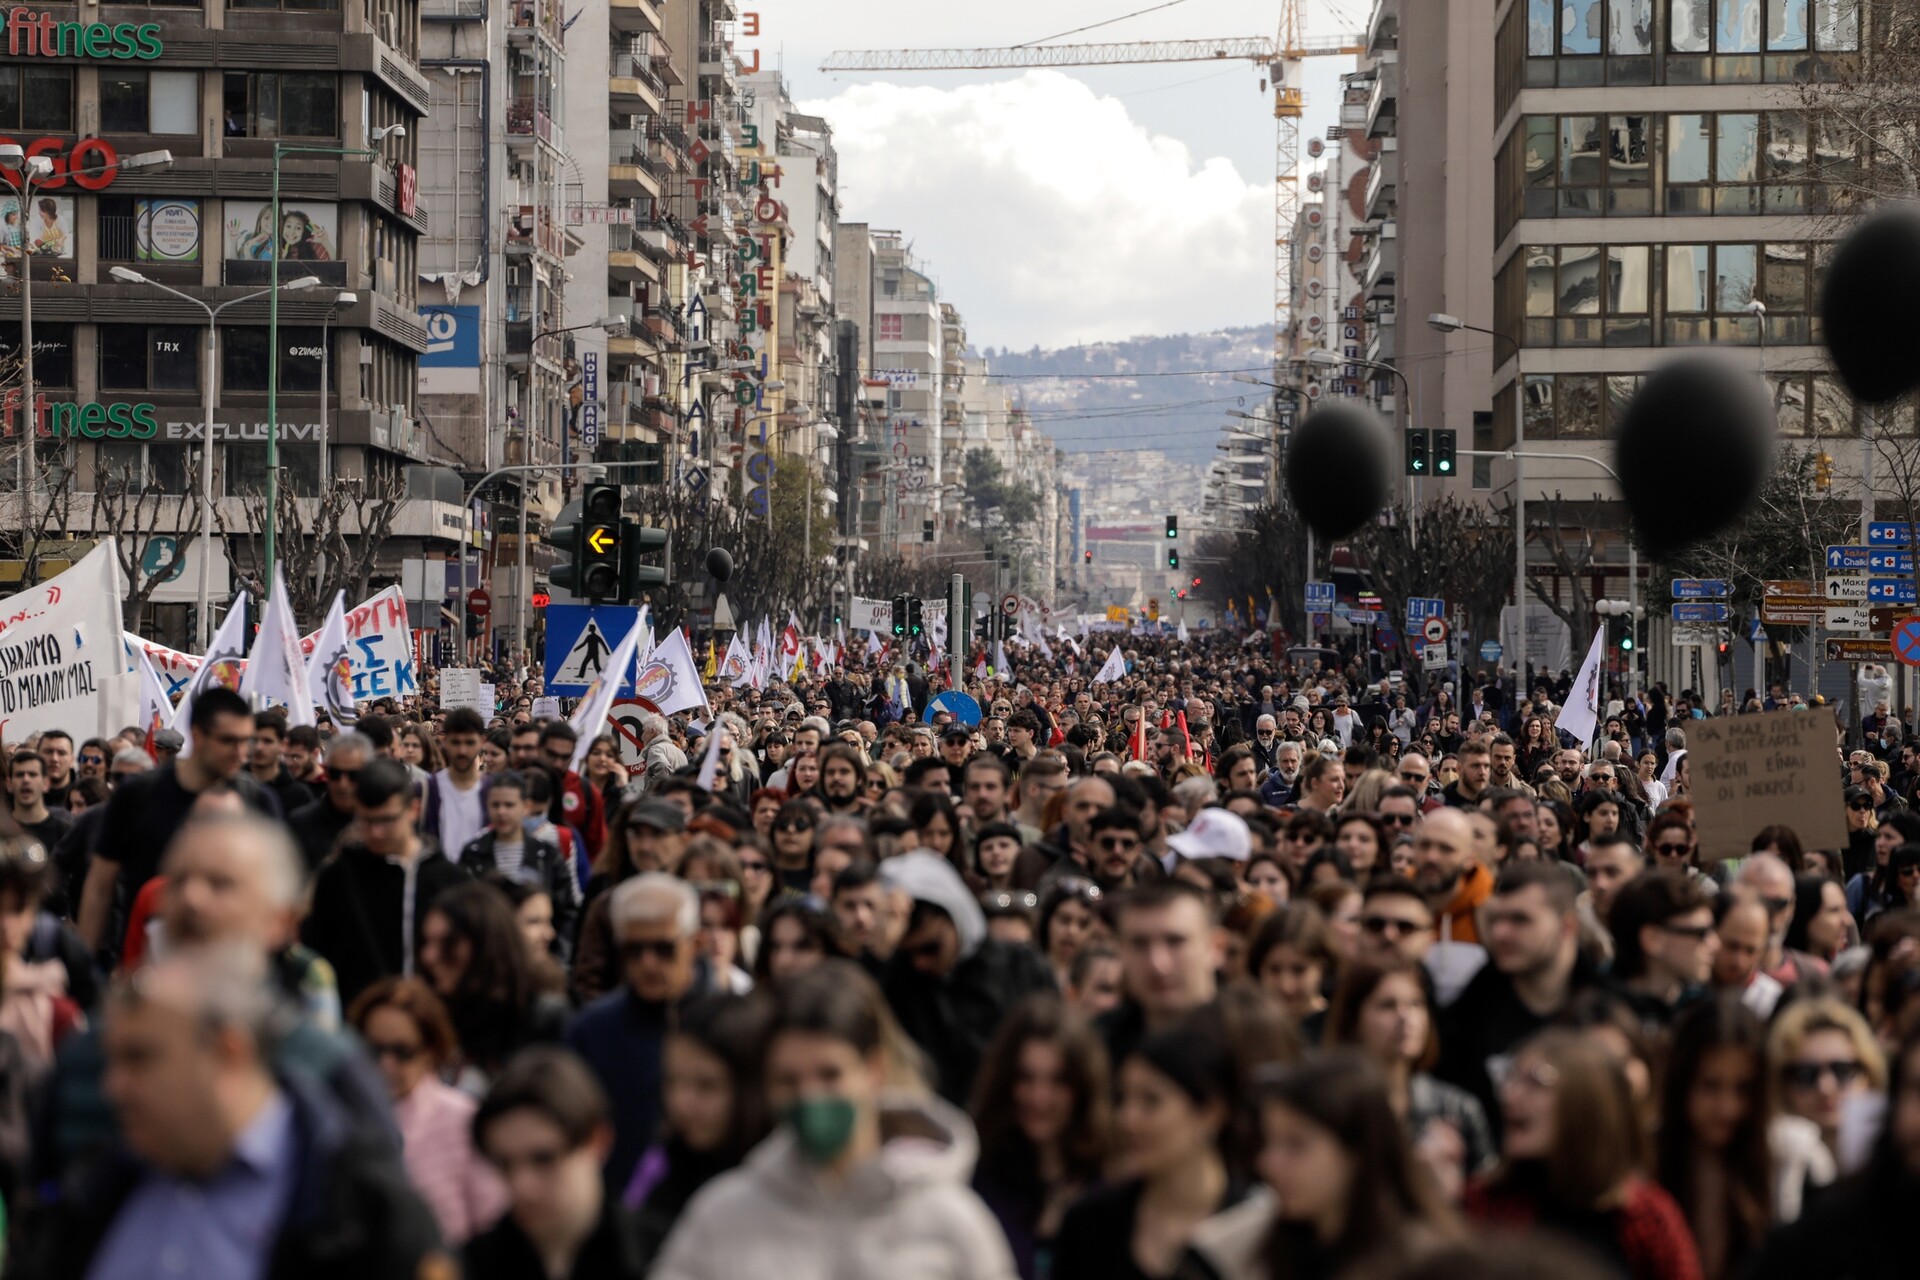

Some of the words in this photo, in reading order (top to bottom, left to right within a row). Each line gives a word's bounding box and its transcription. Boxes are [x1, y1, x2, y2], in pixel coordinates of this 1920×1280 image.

[7, 7, 163, 60] fitness
[686, 100, 711, 271] HOTEL
[571, 207, 633, 224] OTEL
[157, 341, 180, 352] TRX
[1346, 307, 1357, 397] HOTEL
[585, 353, 596, 401] HOTEL
[2, 387, 158, 440] ftness
[585, 406, 596, 444] ARGO
[166, 422, 330, 442] EXCLUSIVE
[1842, 578, 1867, 586] Μακε
[1842, 588, 1867, 596] Mace
[1853, 620, 1869, 628] Por
[1854, 610, 1869, 618] Λιμ
[67, 660, 97, 699] ΜΑΣ
